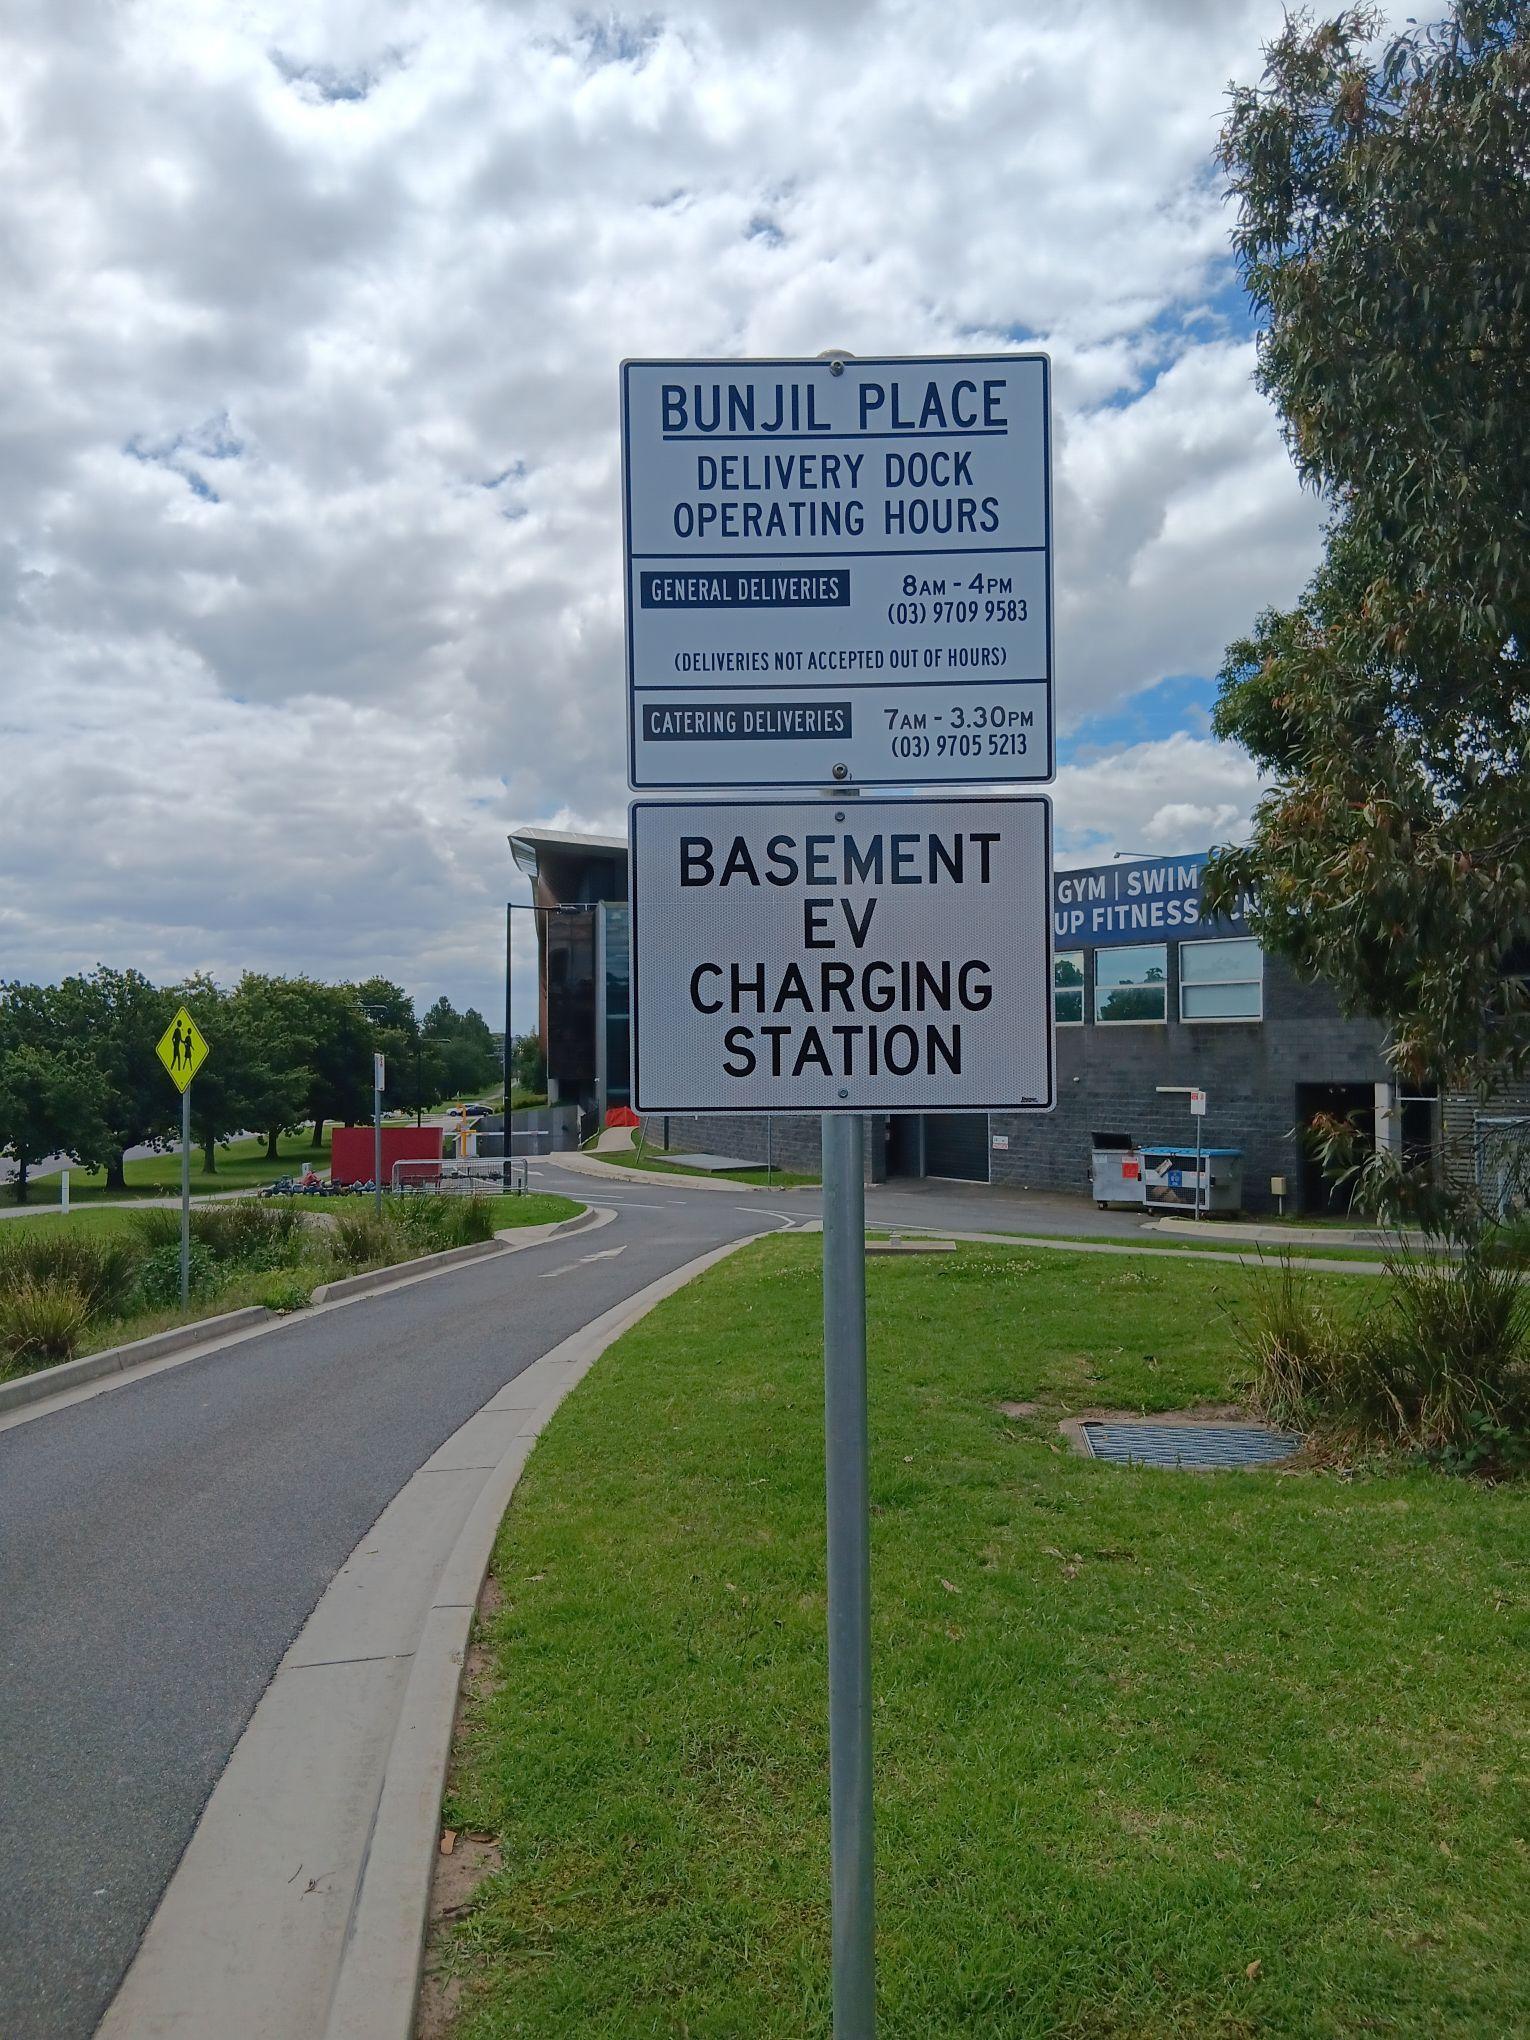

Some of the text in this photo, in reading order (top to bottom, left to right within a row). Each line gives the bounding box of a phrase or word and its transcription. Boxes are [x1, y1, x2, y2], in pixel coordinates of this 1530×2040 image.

[662, 380, 1008, 432] BUNJIL PLACE
[698, 452, 973, 490] DELIVERY DOCK
[674, 497, 998, 537] OPERATING HOURS
[652, 578, 838, 600] GENERAL DELIVERIES
[903, 575, 945, 596] 8AM
[969, 573, 1011, 594] 4PM
[888, 600, 1027, 624] (03) 9709 9583
[675, 647, 1006, 671] (DELIVERIES NOT ACCEPTED OUT OF HOURS)
[652, 710, 843, 733] CATERING DELIVERIES
[884, 709, 926, 730] 7AM
[951, 706, 1033, 728] 3.30PM
[892, 734, 1026, 757] (03) 9705 5213
[680, 833, 1000, 886] BASEMENT
[1058, 876, 1105, 903] GYM
[1127, 865, 1197, 895] SWIM
[804, 898, 877, 949] EV
[1092, 898, 1199, 931] FITNESS
[690, 960, 992, 1014] CHARGING
[723, 1024, 961, 1077] STATION
